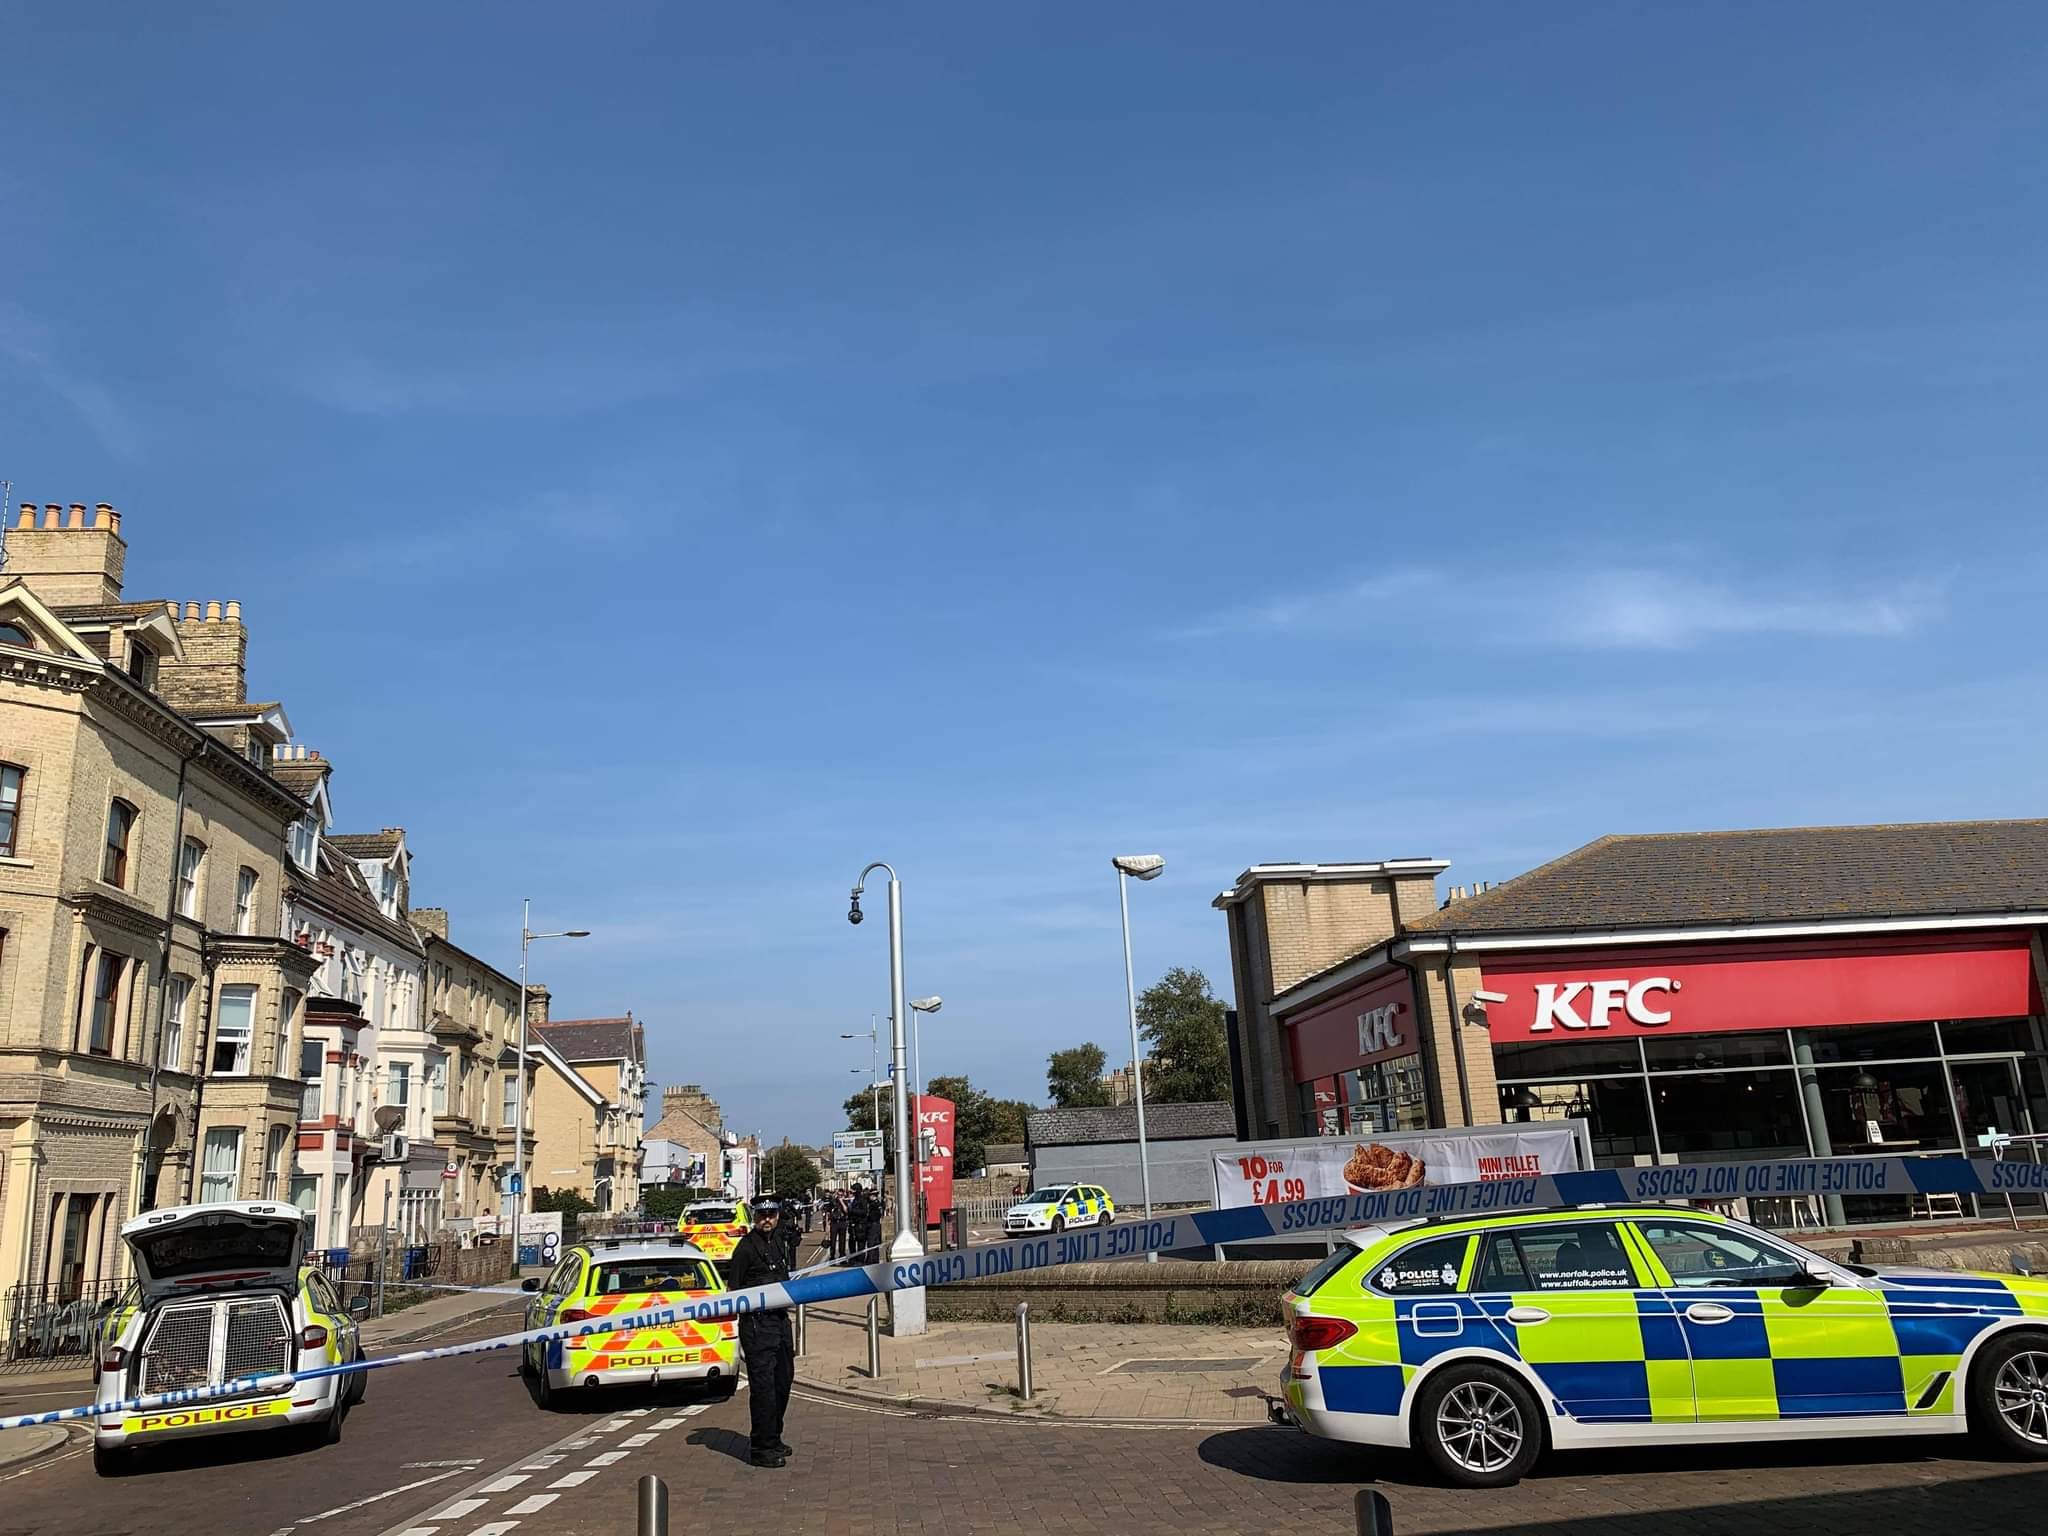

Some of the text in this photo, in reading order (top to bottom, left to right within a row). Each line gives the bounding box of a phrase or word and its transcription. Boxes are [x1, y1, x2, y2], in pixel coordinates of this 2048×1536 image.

[1529, 976, 1672, 1032] KFC
[1357, 1003, 1402, 1056] KFC
[919, 1111, 950, 1123] KFC
[1238, 1157, 1285, 1180] 10 FOR
[1478, 1155, 1539, 1173] MINI FILLET
[1252, 1178, 1305, 1204] £4.99
[1636, 1162, 1887, 1197] POLICE LINE DO NOT CROSS
[1282, 1179, 1537, 1230] POLICE LINE DO NOT CROSS
[1068, 1214, 1096, 1225] POLICE
[1056, 1233, 1100, 1264] LINE
[1105, 1220, 1176, 1258] POLICE
[1021, 1240, 1048, 1269] DO
[1399, 1269, 1439, 1280] POLICE
[1540, 1268, 1627, 1279] www.norfolk.police.uk
[1541, 1278, 1629, 1288] www.suffolk.police.uk
[609, 1352, 700, 1368] POLICE
[140, 1404, 273, 1430] POLICE
